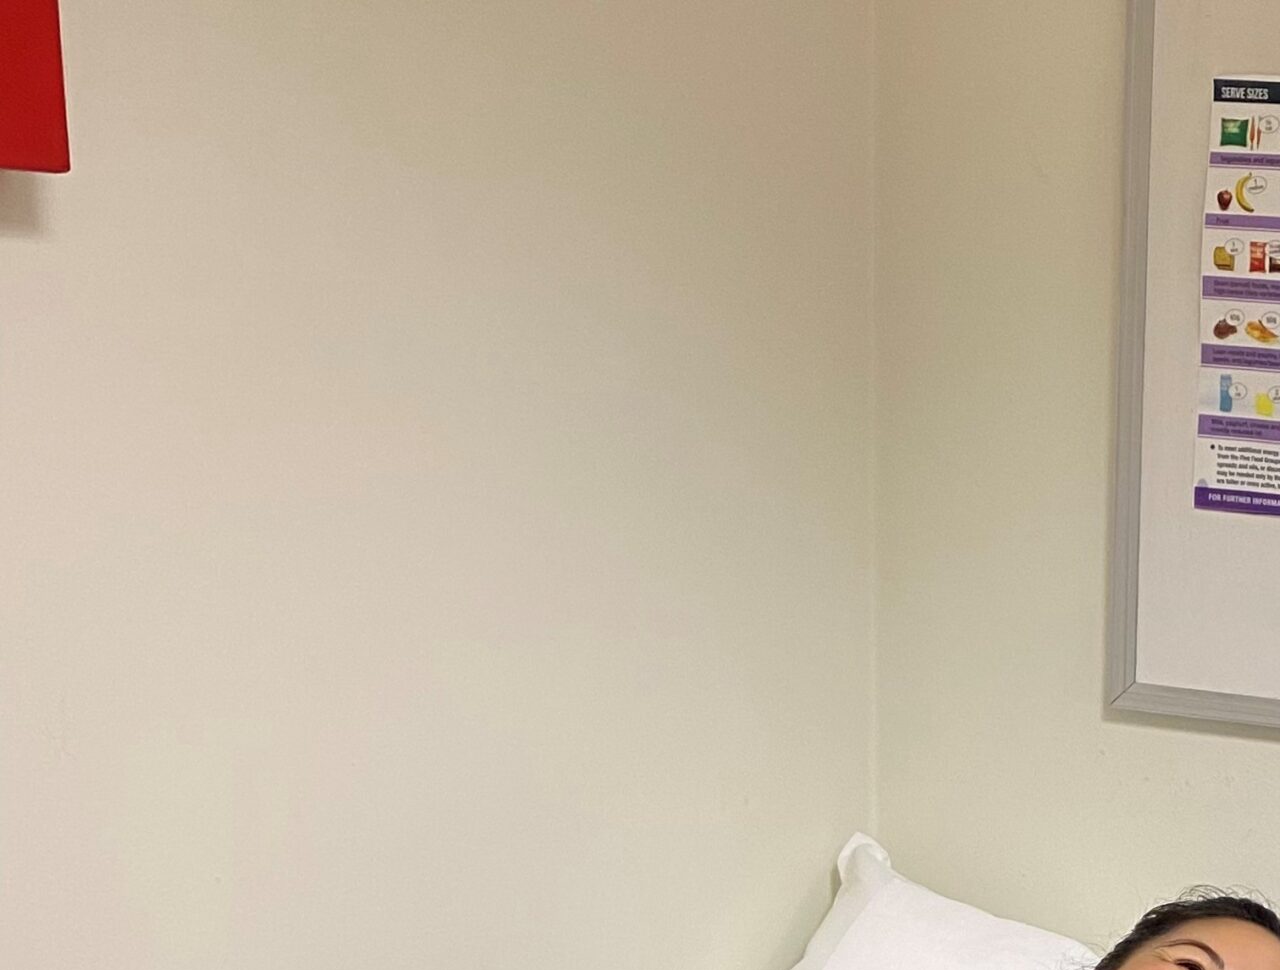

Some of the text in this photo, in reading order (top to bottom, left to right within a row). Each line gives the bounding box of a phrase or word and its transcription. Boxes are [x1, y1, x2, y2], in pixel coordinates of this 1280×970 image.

[1221, 87, 1268, 100] SERVE SIZES
[1208, 493, 1222, 501] FOR
[1223, 494, 1251, 504] FURTHER
